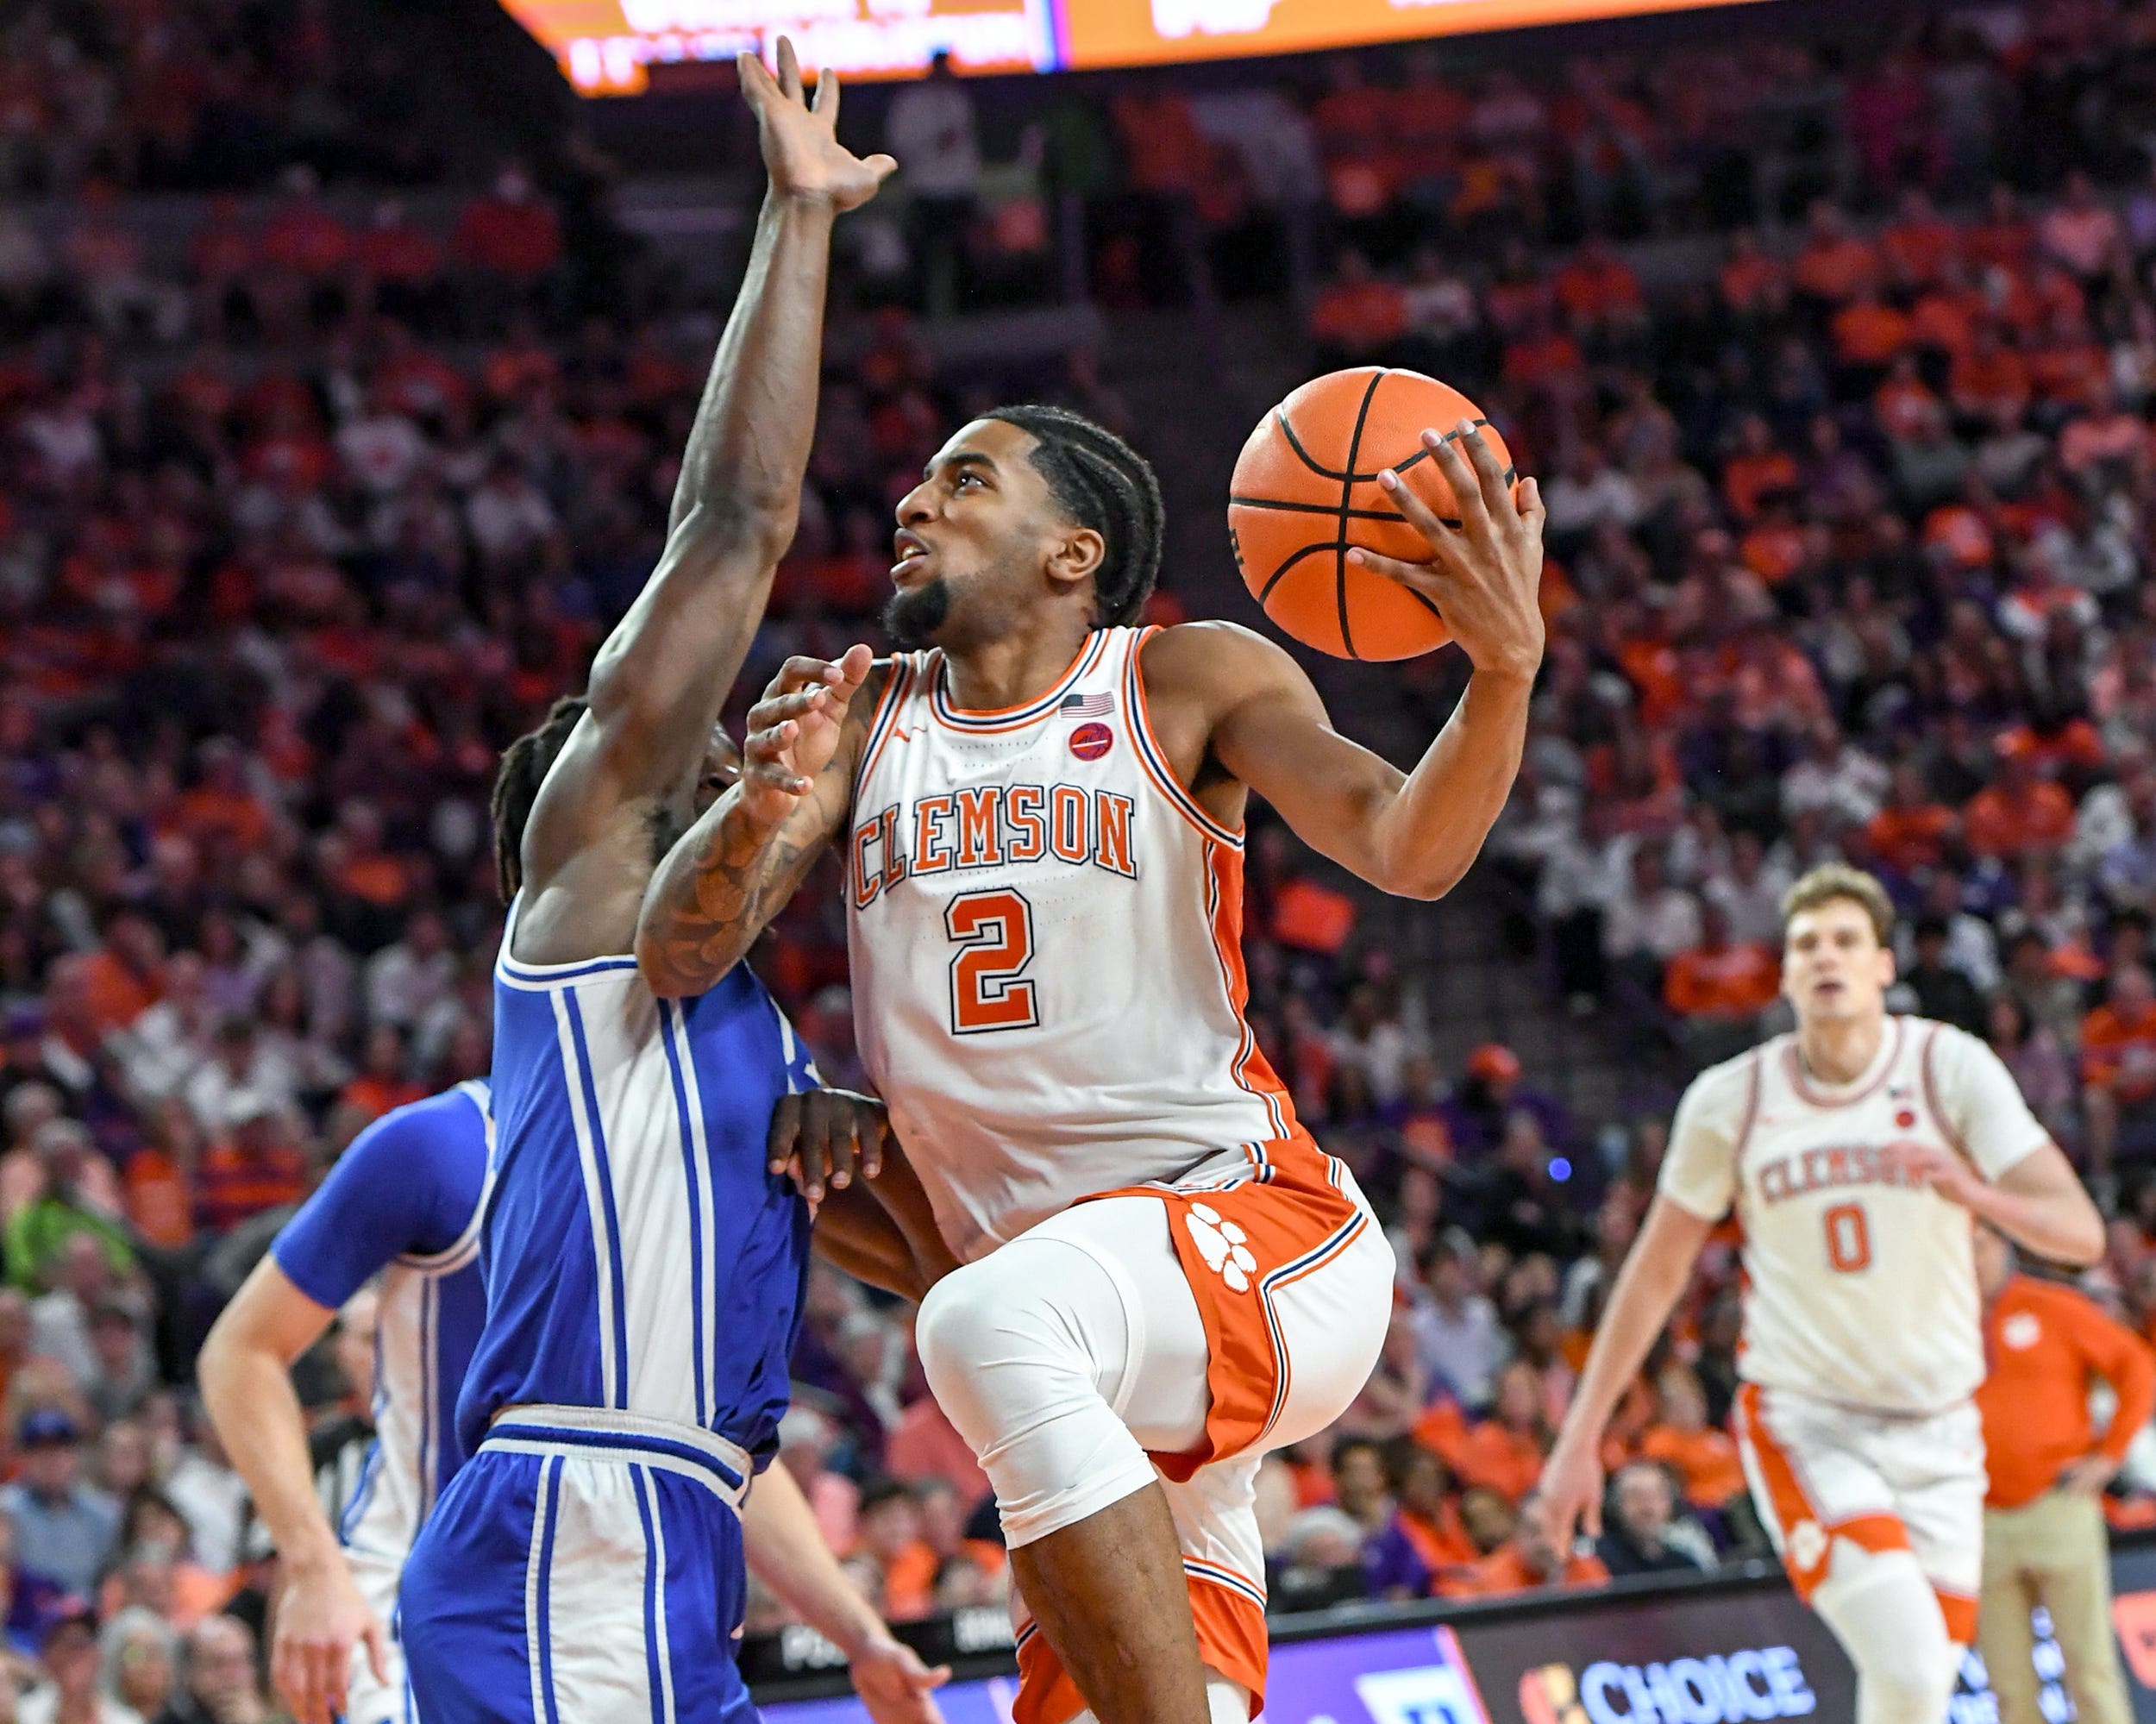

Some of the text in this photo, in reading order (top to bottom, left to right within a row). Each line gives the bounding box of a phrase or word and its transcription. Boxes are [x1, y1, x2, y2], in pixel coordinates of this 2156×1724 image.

[853, 782, 1138, 911] CLEMSON
[943, 887, 1040, 1036] 2
[1824, 1202, 1872, 1275] 0
[1581, 1646, 1816, 1724] CHOICE
